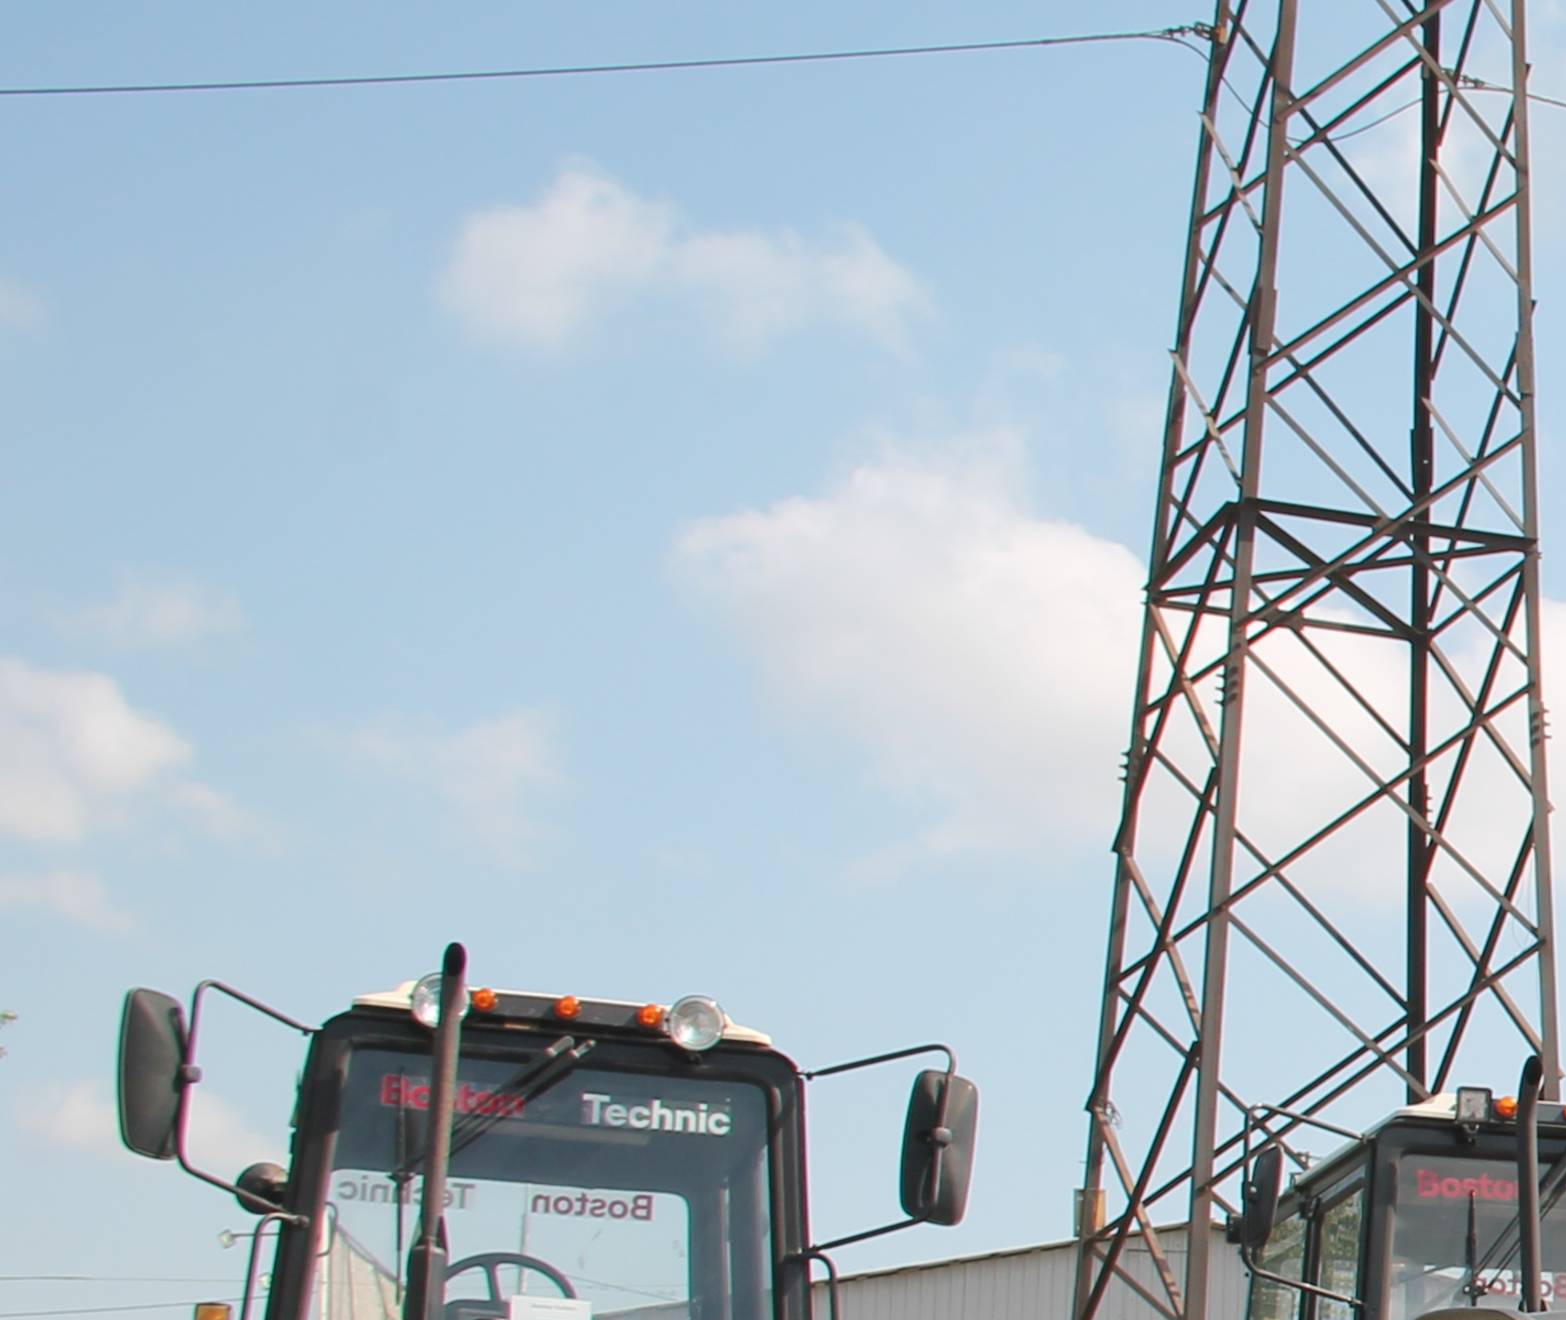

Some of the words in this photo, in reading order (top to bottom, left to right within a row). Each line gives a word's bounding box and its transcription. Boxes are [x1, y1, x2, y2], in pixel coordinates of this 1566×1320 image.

[381, 1074, 525, 1117] Boton
[582, 1092, 731, 1135] Technic
[1416, 1169, 1518, 1200] Bosto
